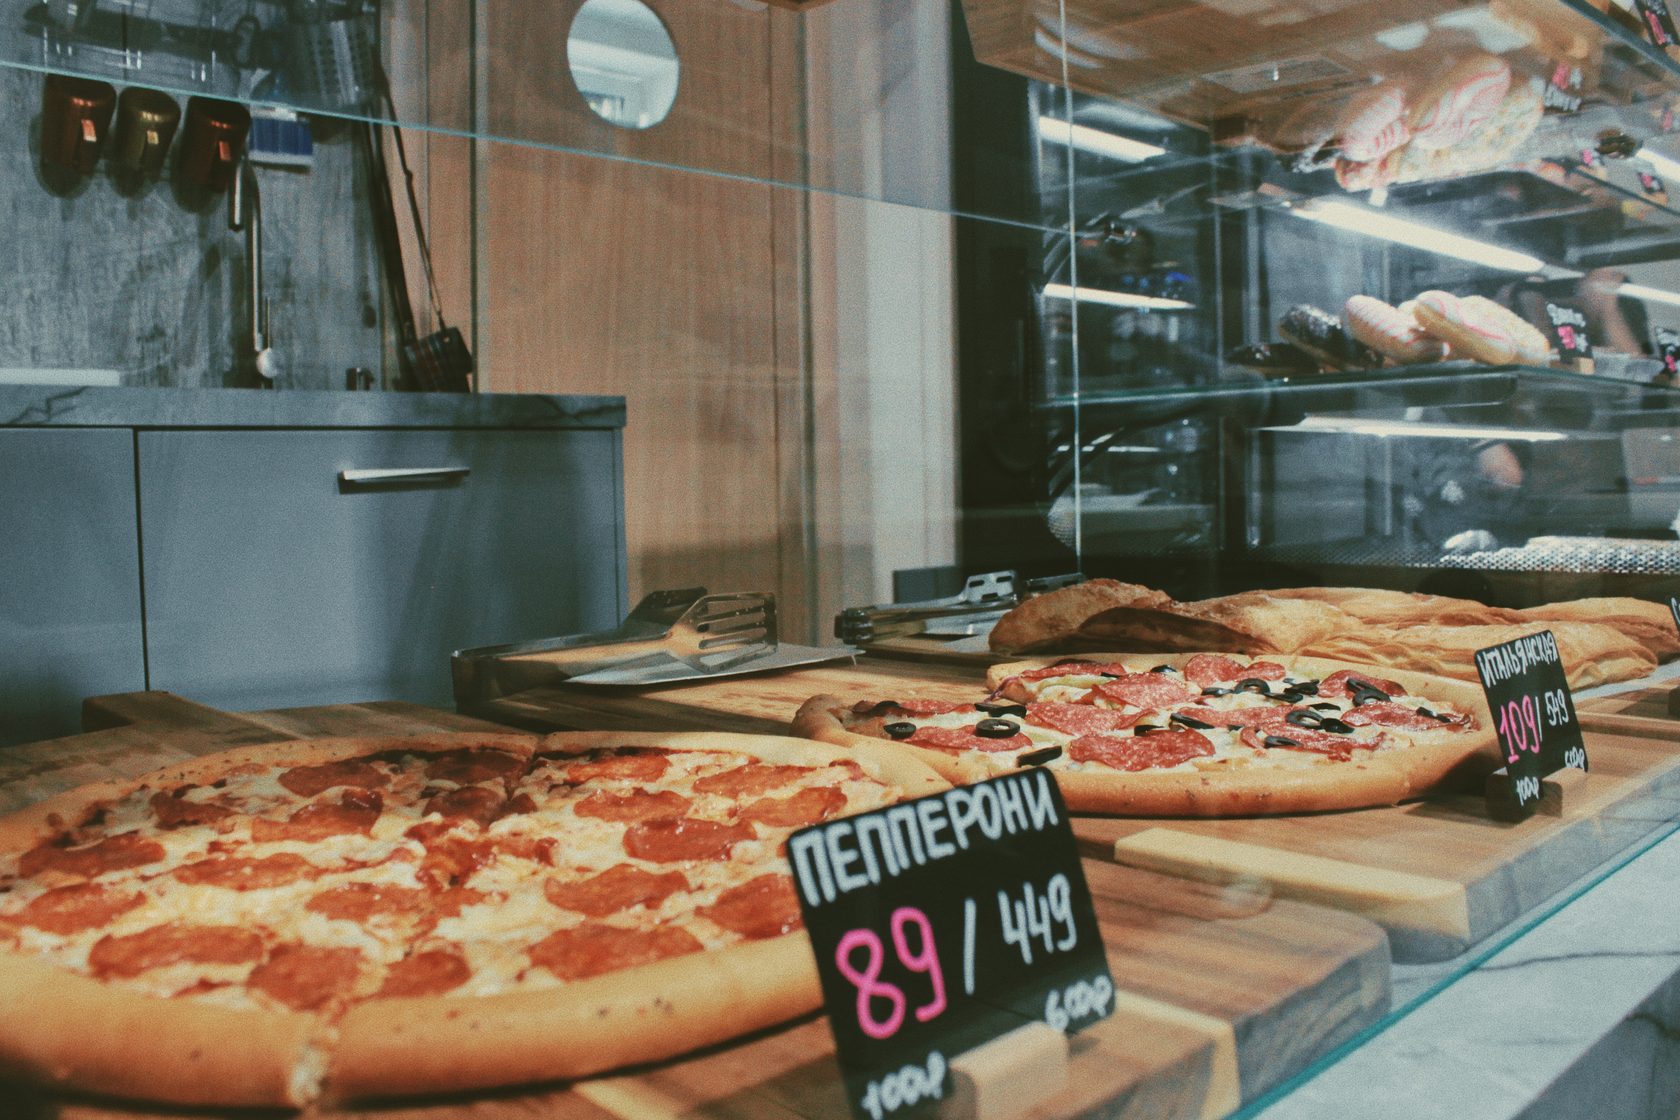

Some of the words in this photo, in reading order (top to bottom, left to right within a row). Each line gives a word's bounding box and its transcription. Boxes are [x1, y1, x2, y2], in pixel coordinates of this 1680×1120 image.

[1476, 632, 1559, 688] ИТАЛЬЯНСКАЯ
[789, 770, 1059, 907] ПЕППЕРОНИ
[834, 906, 948, 1040] 89
[998, 872, 1078, 965] 449
